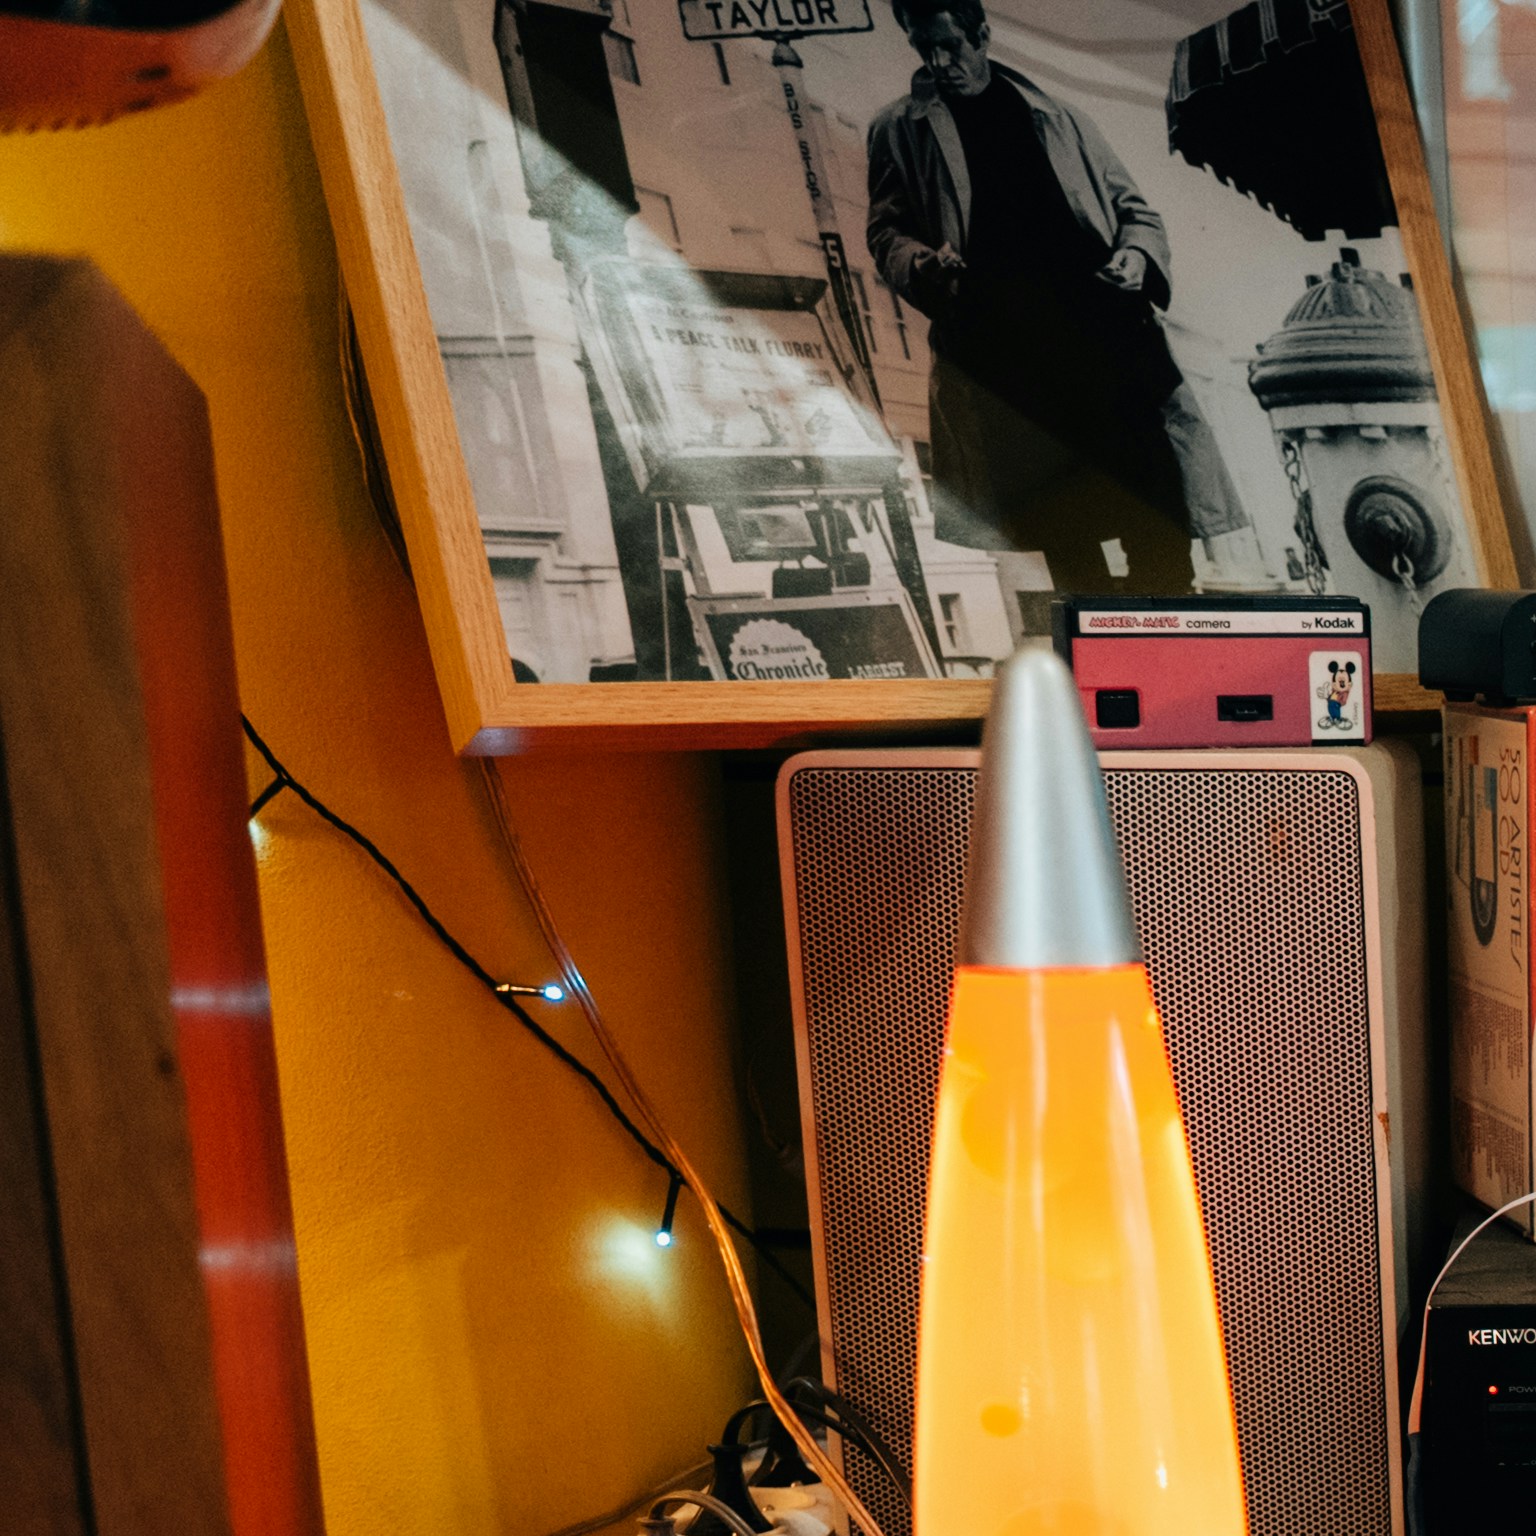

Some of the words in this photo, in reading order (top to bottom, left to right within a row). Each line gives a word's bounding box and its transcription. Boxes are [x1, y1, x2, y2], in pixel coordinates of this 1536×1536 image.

[706, 0, 839, 30] TAYLOR
[724, 336, 761, 355] TALK
[765, 339, 824, 360] FLURRY
[1186, 618, 1231, 629] camera
[1301, 620, 1312, 630] by
[1315, 617, 1355, 629] Kodak
[737, 656, 826, 681] Chronicle
[1499, 745, 1510, 804] 50
[1510, 745, 1522, 806] 50
[1499, 815, 1511, 877] CD
[1509, 815, 1522, 975] ARTISTES
